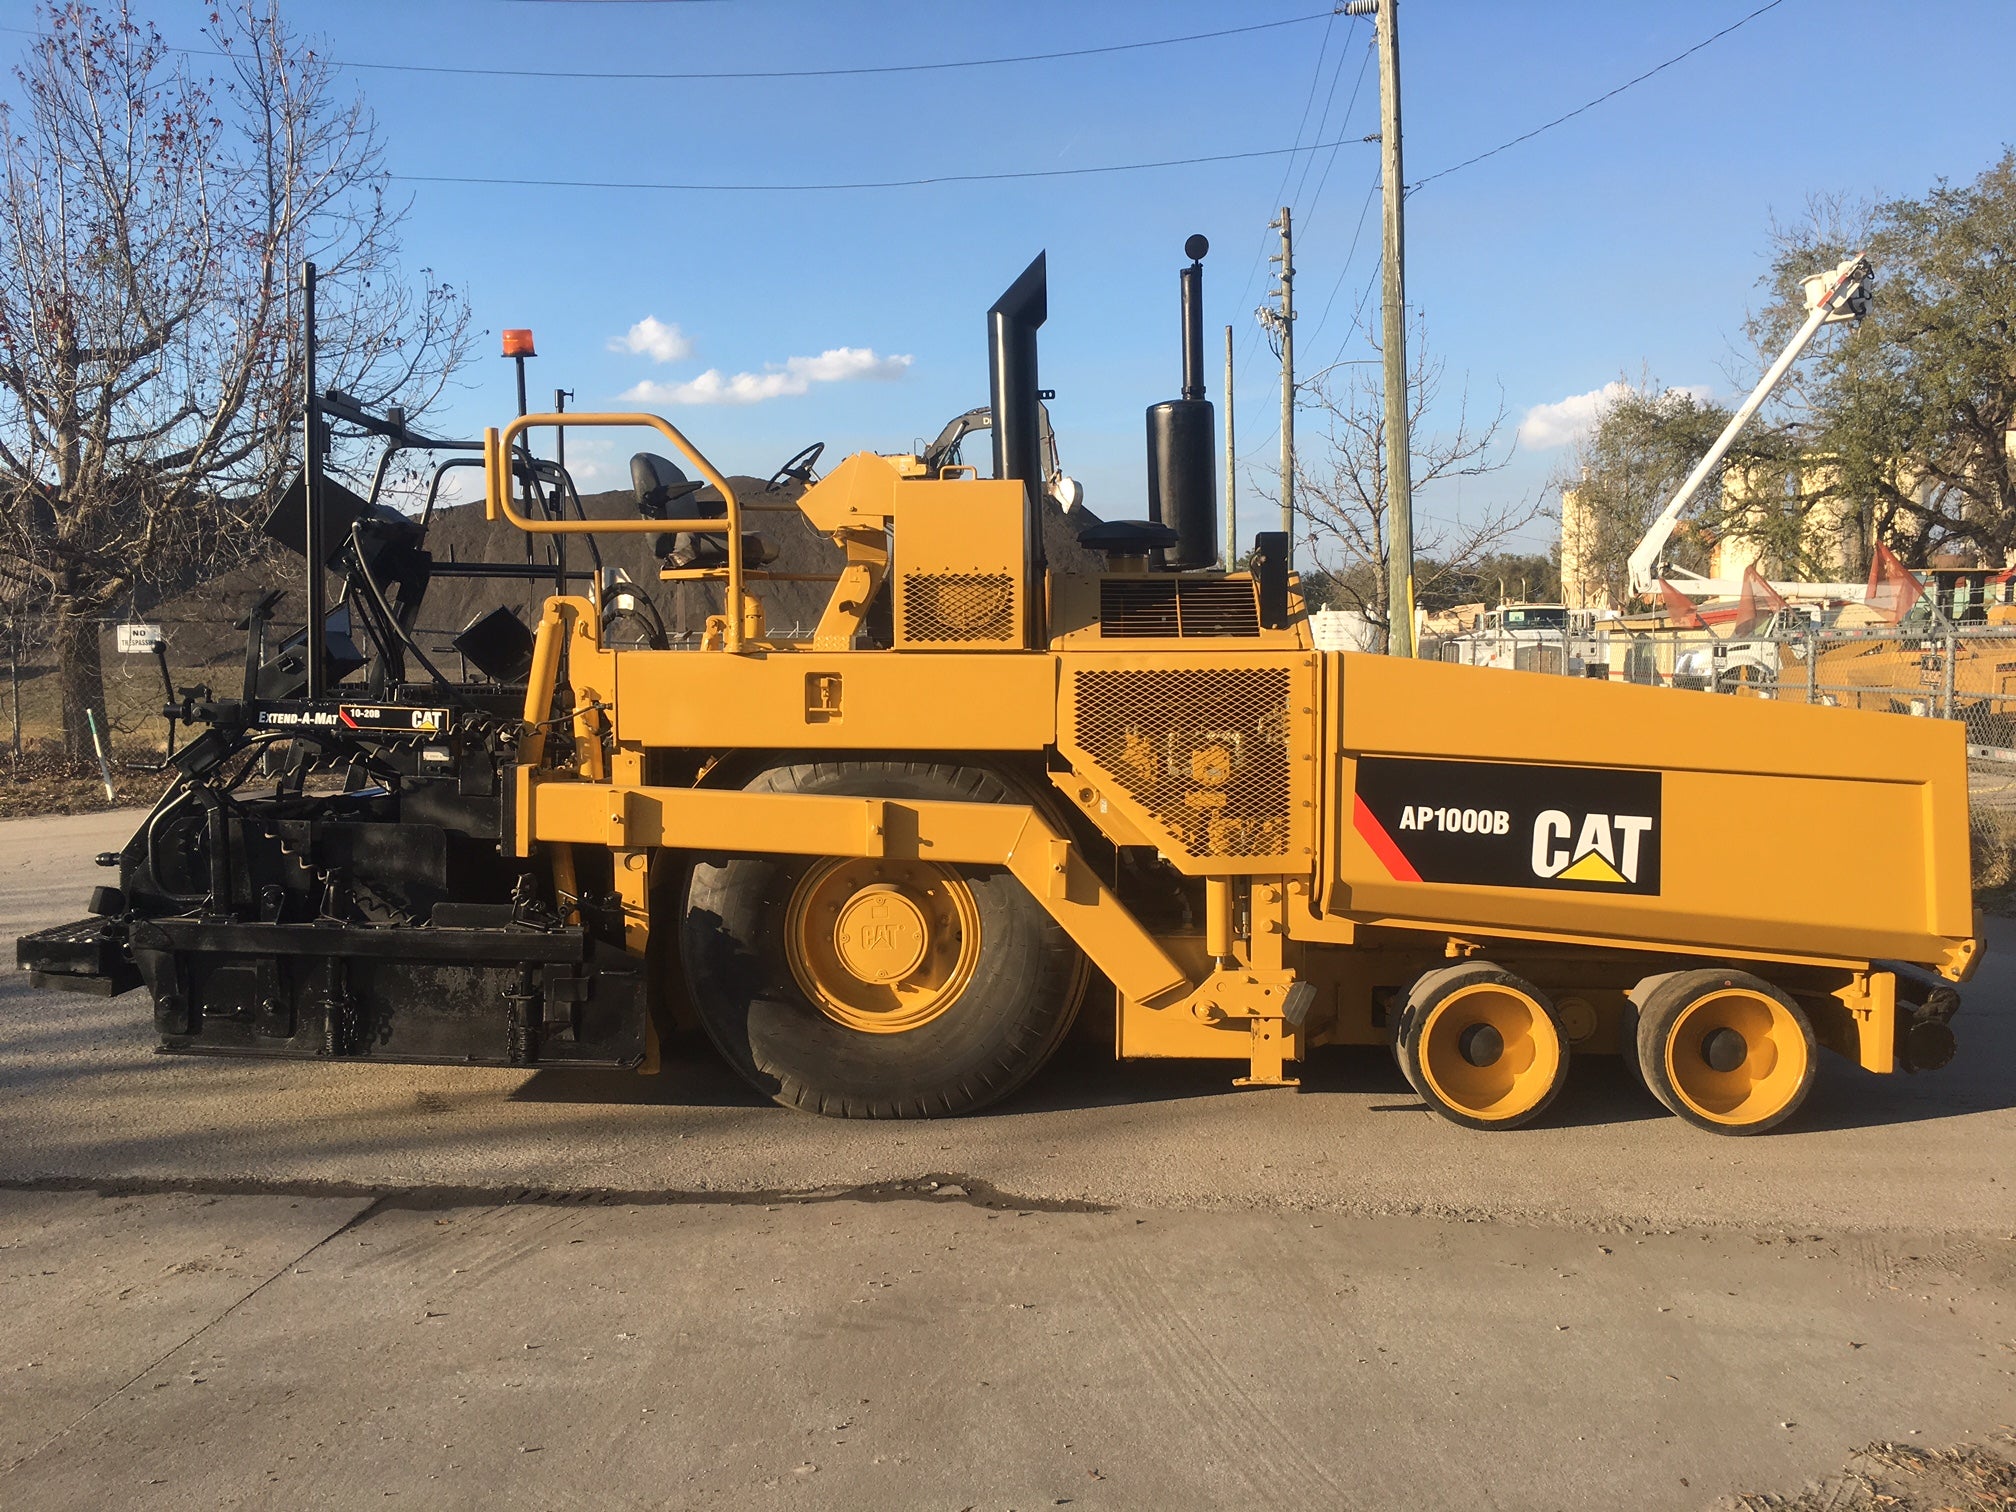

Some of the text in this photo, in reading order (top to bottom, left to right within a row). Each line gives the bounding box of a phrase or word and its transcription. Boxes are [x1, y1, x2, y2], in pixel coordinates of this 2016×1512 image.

[350, 708, 443, 729] 10-20B CAT
[1399, 805, 1653, 884] AP1000B CAT
[861, 924, 898, 950] CAT
